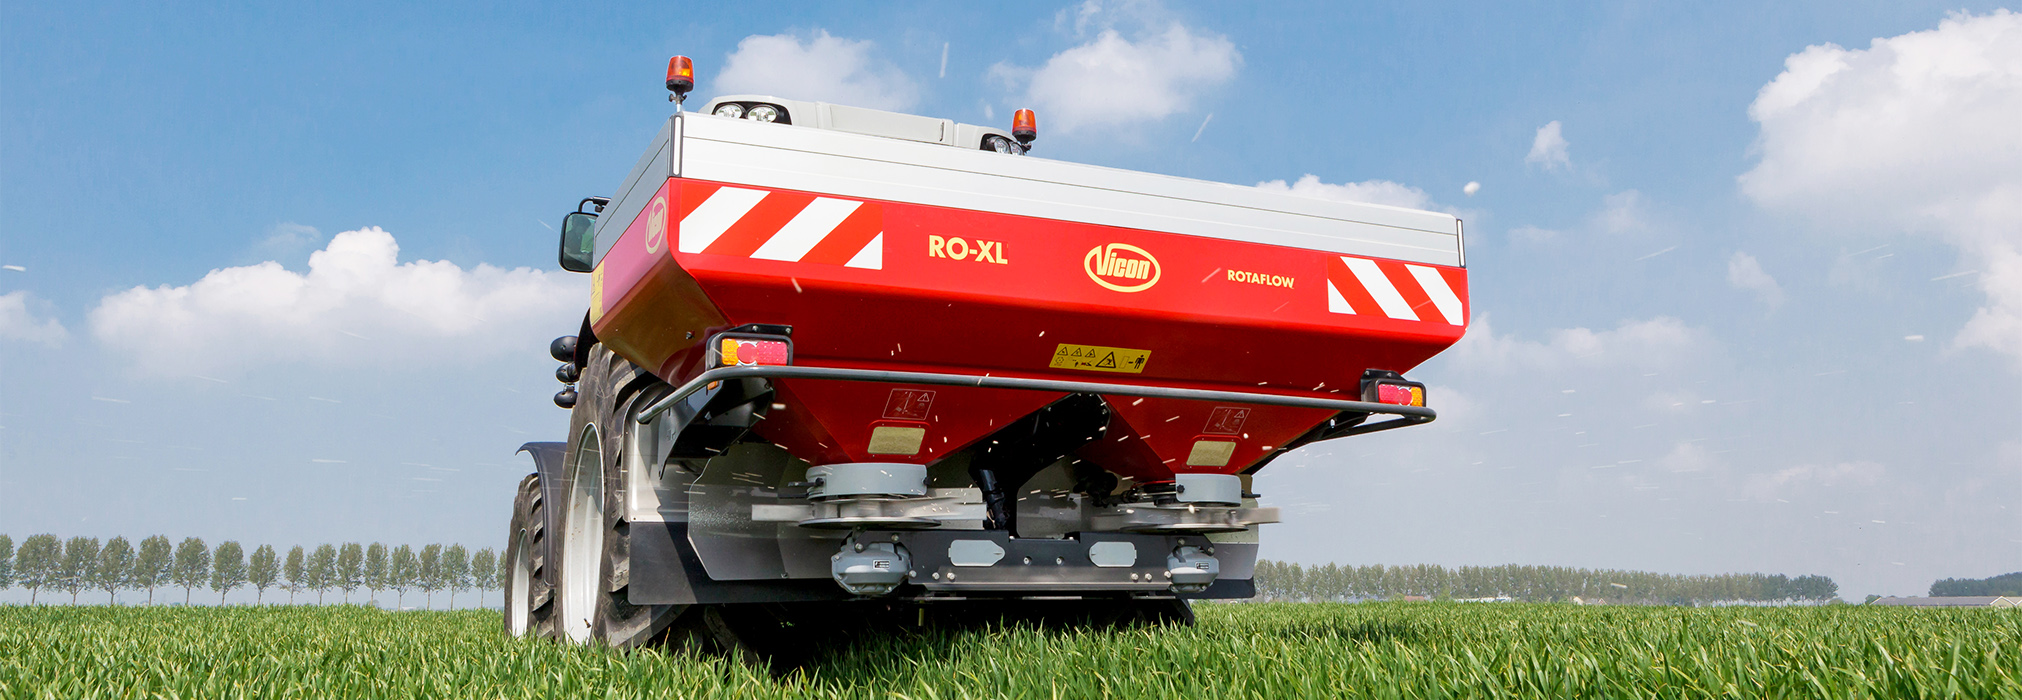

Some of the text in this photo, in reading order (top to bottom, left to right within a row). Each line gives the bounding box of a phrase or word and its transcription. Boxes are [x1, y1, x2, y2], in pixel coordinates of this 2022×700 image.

[928, 234, 1008, 265] RO-XL
[1096, 243, 1151, 280] Vicon
[1227, 269, 1295, 289] ROTAFLOW
